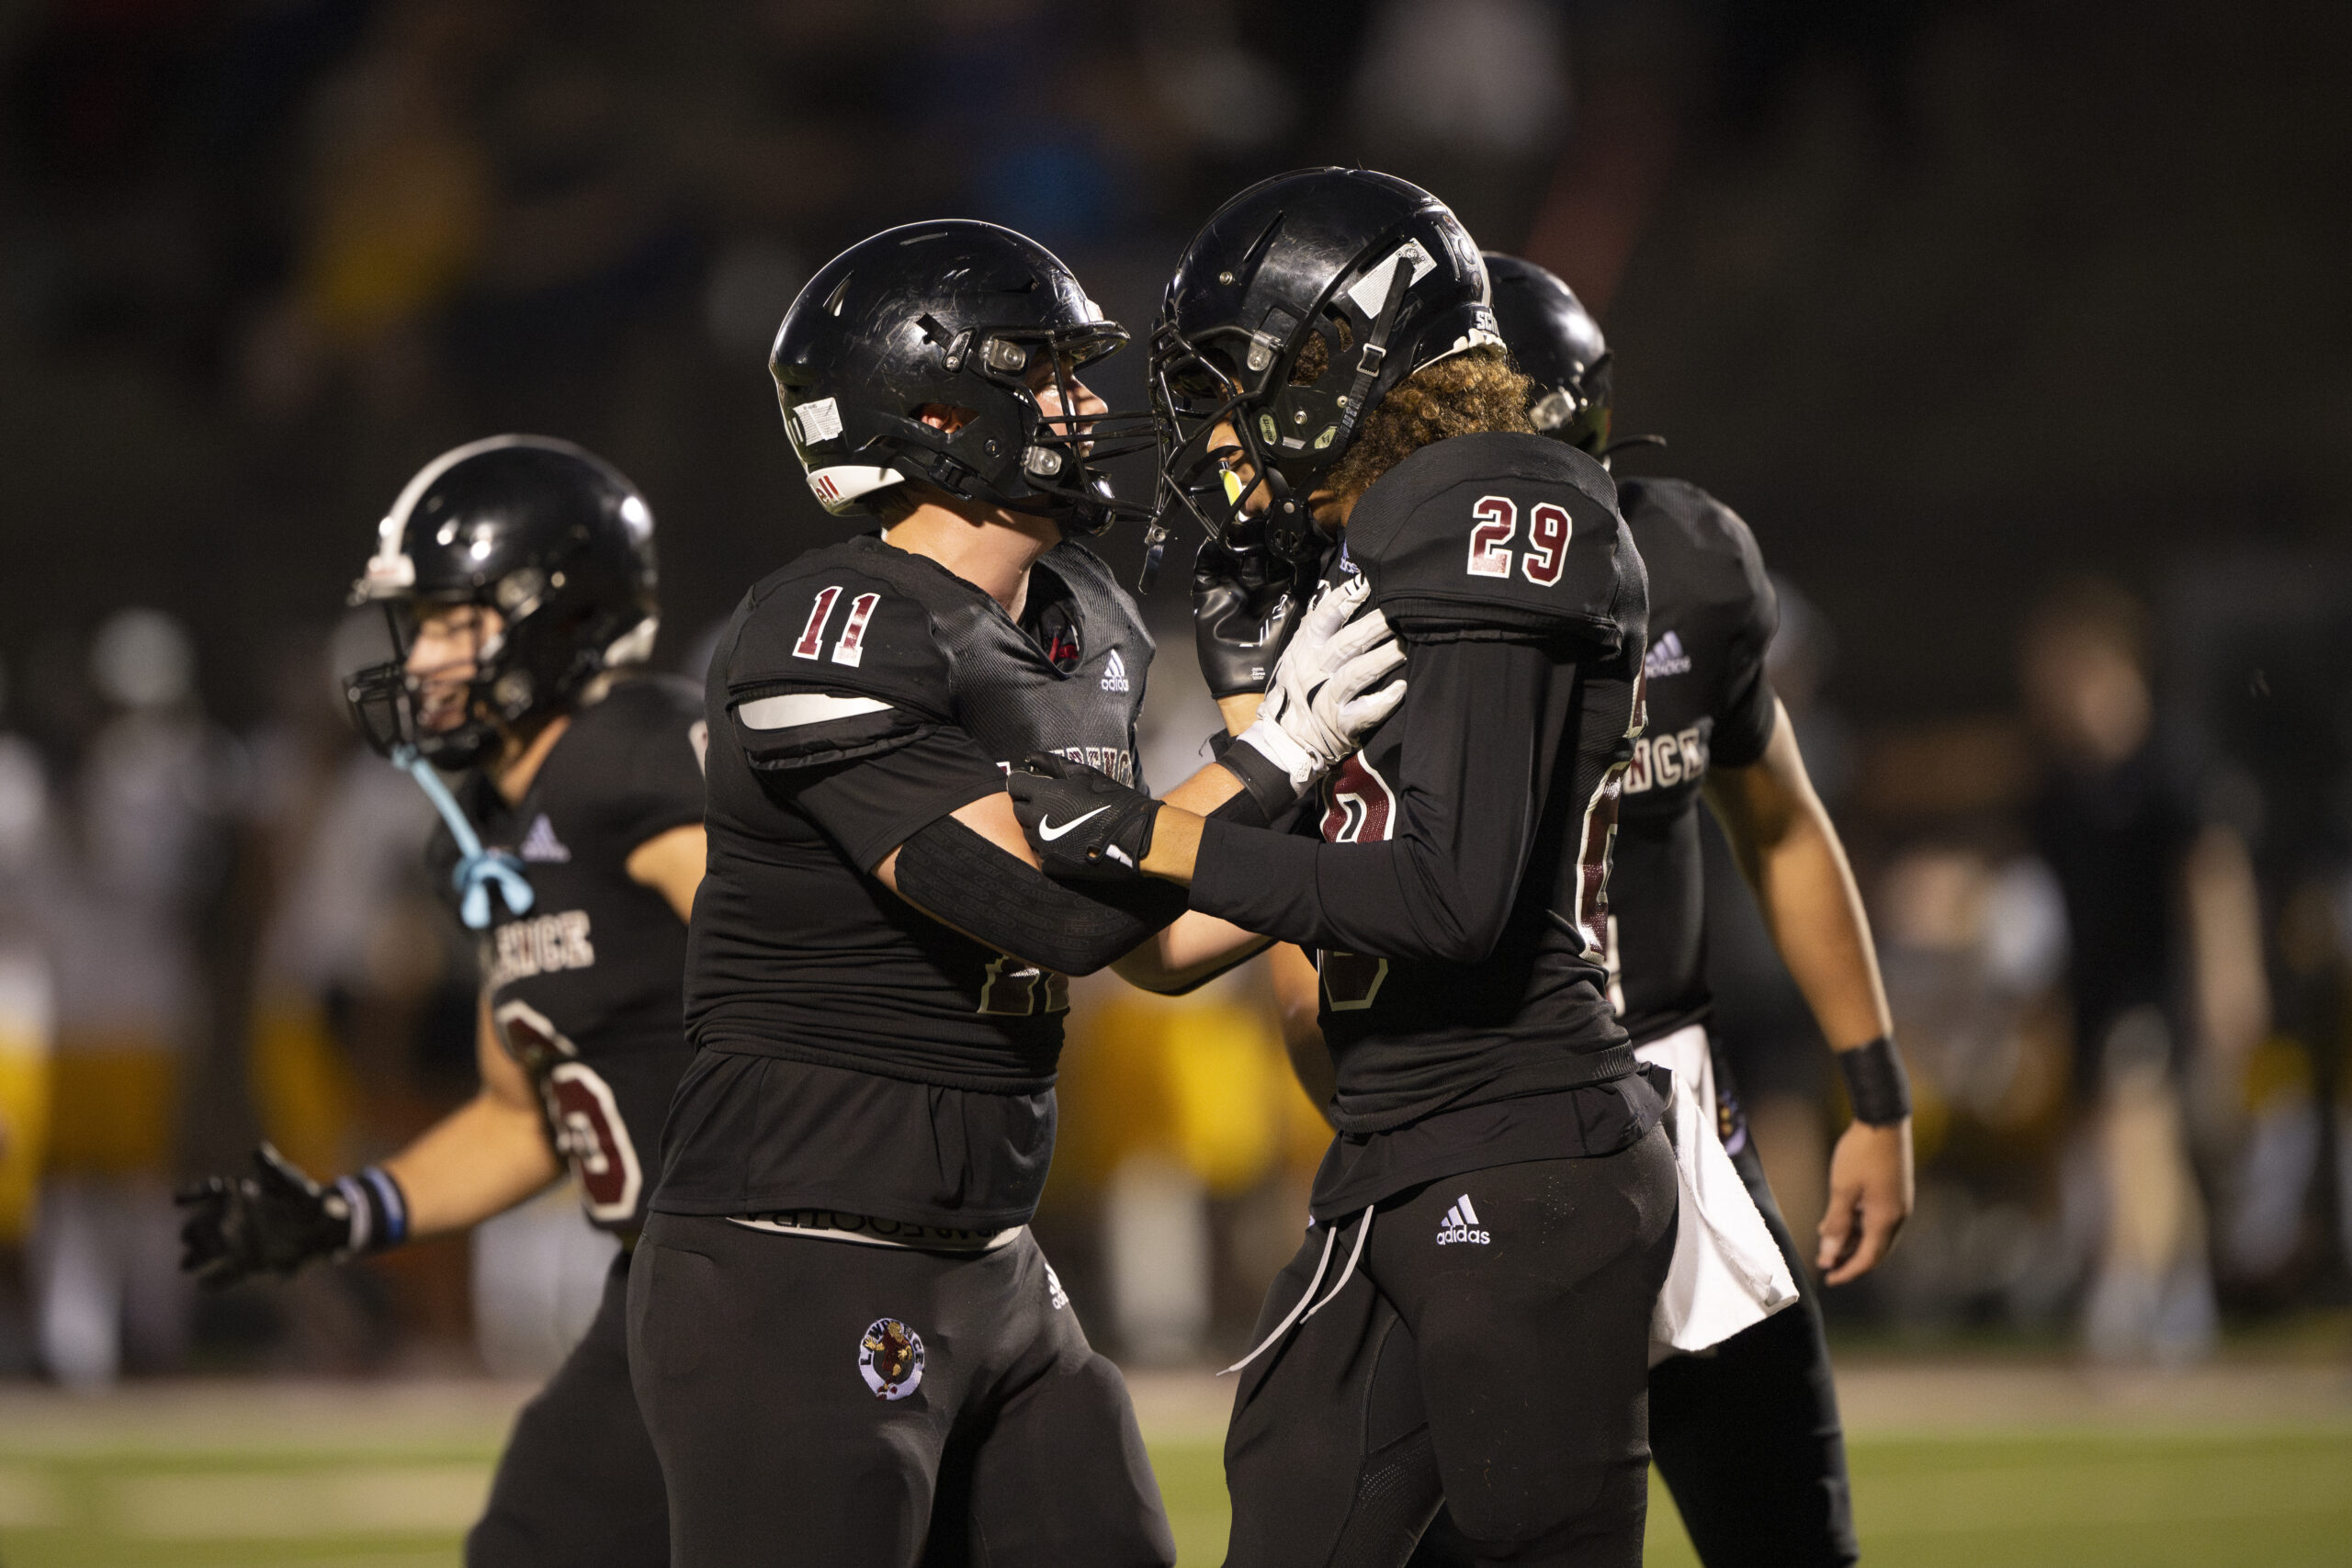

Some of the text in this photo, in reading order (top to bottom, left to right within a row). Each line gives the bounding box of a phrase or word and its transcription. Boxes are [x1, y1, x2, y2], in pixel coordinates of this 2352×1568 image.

[1467, 495, 1572, 587] 29
[792, 585, 881, 668] 11
[1101, 674, 1130, 693] adidas
[1436, 1224, 1491, 1246] adidas
